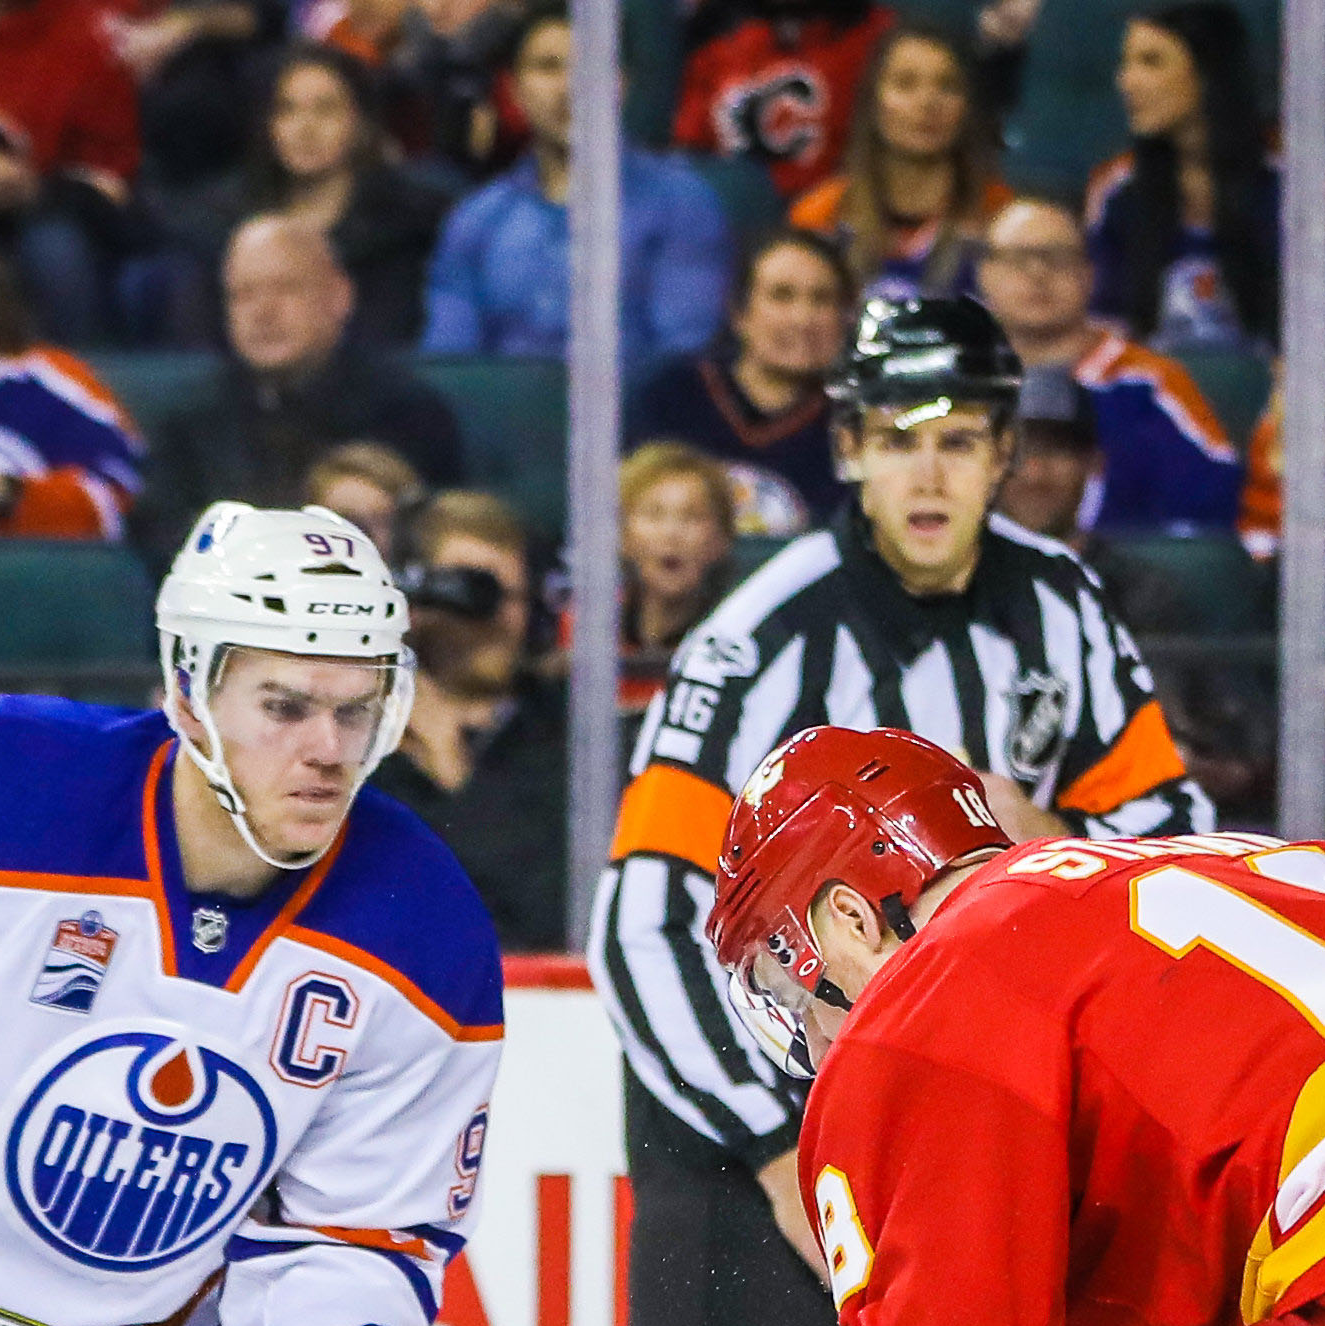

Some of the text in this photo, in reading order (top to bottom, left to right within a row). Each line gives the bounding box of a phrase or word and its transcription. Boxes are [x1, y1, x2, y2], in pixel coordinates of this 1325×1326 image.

[302, 532, 355, 558] 97
[306, 602, 375, 617] CCM
[952, 787, 997, 828] 18
[269, 970, 360, 1090] C
[39, 1103, 249, 1202] OILERS
